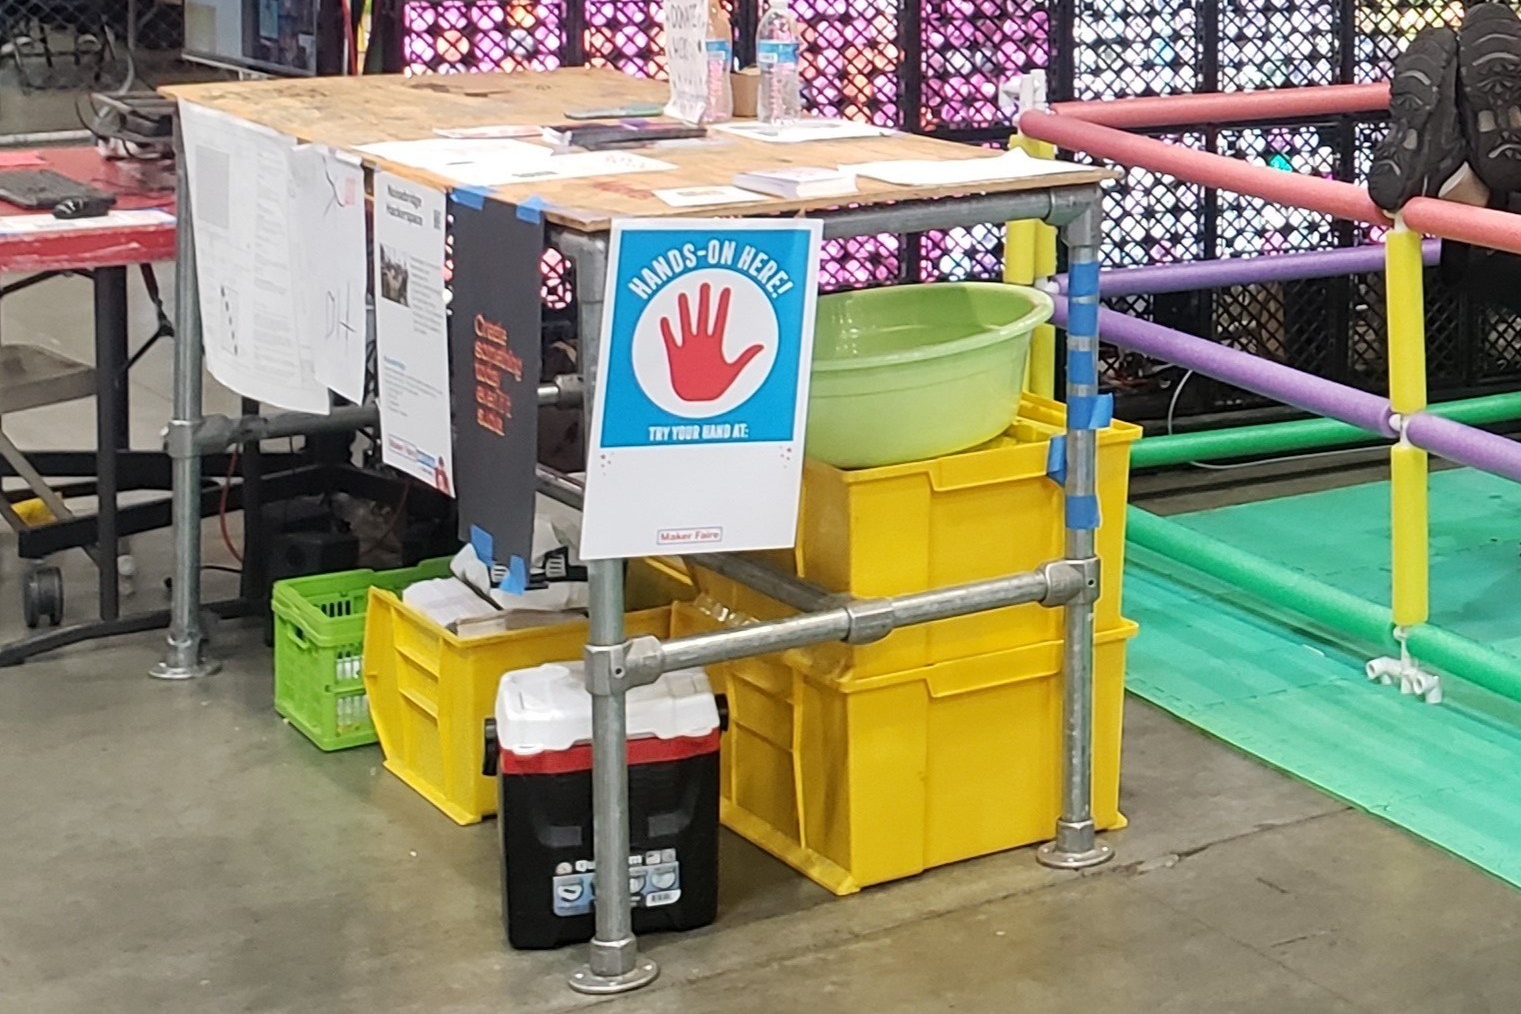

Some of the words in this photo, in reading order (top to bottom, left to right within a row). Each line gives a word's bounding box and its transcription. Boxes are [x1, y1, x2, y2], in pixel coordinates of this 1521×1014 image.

[628, 239, 736, 299] HANDS-ON
[737, 245, 794, 299] HERE!
[474, 313, 507, 346] Create
[649, 426, 671, 441] TRY
[672, 425, 700, 440] YOUR
[702, 424, 731, 439] HAND
[732, 423, 750, 438] AT:
[660, 532, 692, 541] Maker
[695, 530, 719, 540] Faire
